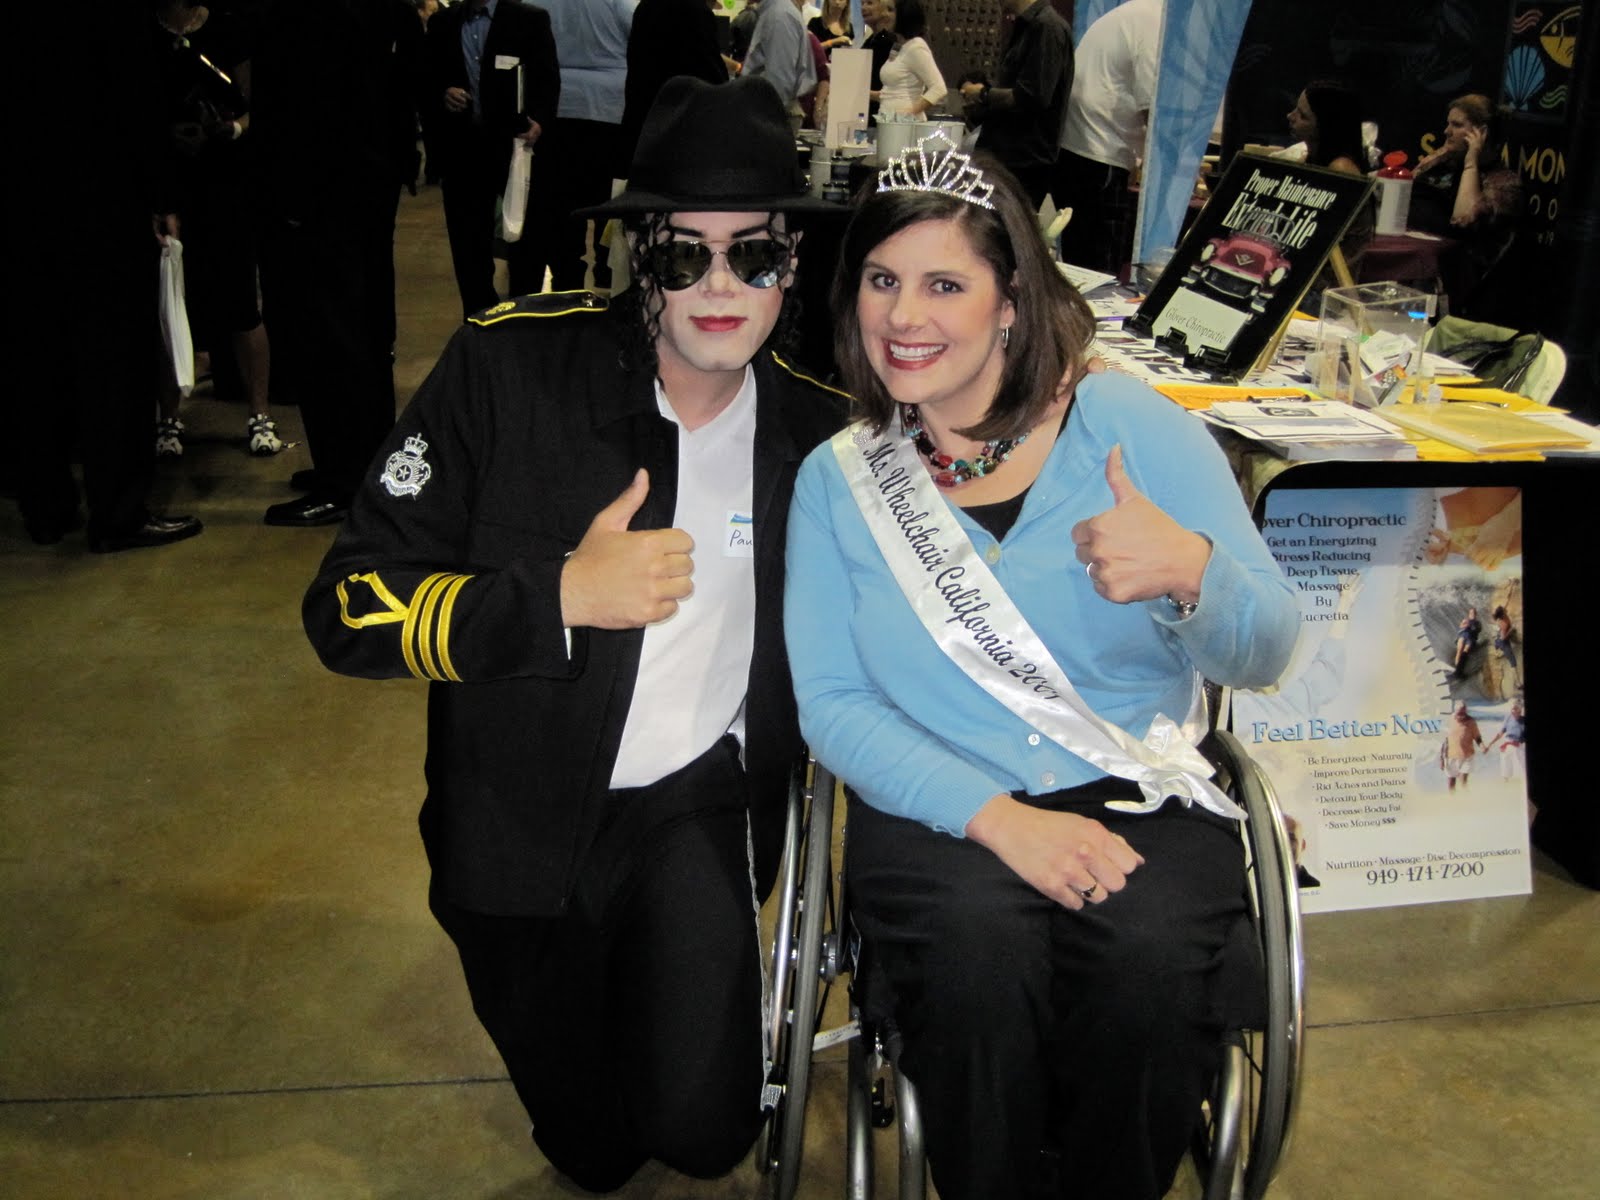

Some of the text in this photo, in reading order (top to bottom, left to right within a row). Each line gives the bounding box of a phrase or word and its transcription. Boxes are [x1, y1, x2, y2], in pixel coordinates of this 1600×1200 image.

[1244, 169, 1337, 210] Proper Maintenance
[1280, 206, 1318, 249] Life
[1166, 307, 1227, 343] Glover Chiropractic
[863, 442, 896, 478] Ms.
[879, 468, 949, 573] Wheelchair
[1298, 513, 1407, 529] Chiropractic
[729, 529, 753, 547] Pau
[1267, 536, 1377, 547] Get an Energizing
[1272, 550, 1371, 562] Stress Reducing
[1287, 566, 1318, 578] Deep
[1298, 582, 1350, 592] Massage
[1315, 596, 1332, 607] By
[935, 566, 1013, 667] California
[1299, 611, 1349, 622] Lucretia
[1252, 713, 1442, 743] Feel Better Now
[1308, 752, 1412, 765] Be Energized Naturally
[1313, 766, 1407, 779] Improve Performance
[1316, 777, 1406, 790] Rid Aches and Pains
[1320, 790, 1403, 804] Detoxify Your Body
[1323, 802, 1401, 816] Decrease Body Fat
[1329, 820, 1349, 829] Save
[1351, 818, 1381, 828] Money
[1326, 847, 1521, 870] Nutrition Massage Disc Decompression
